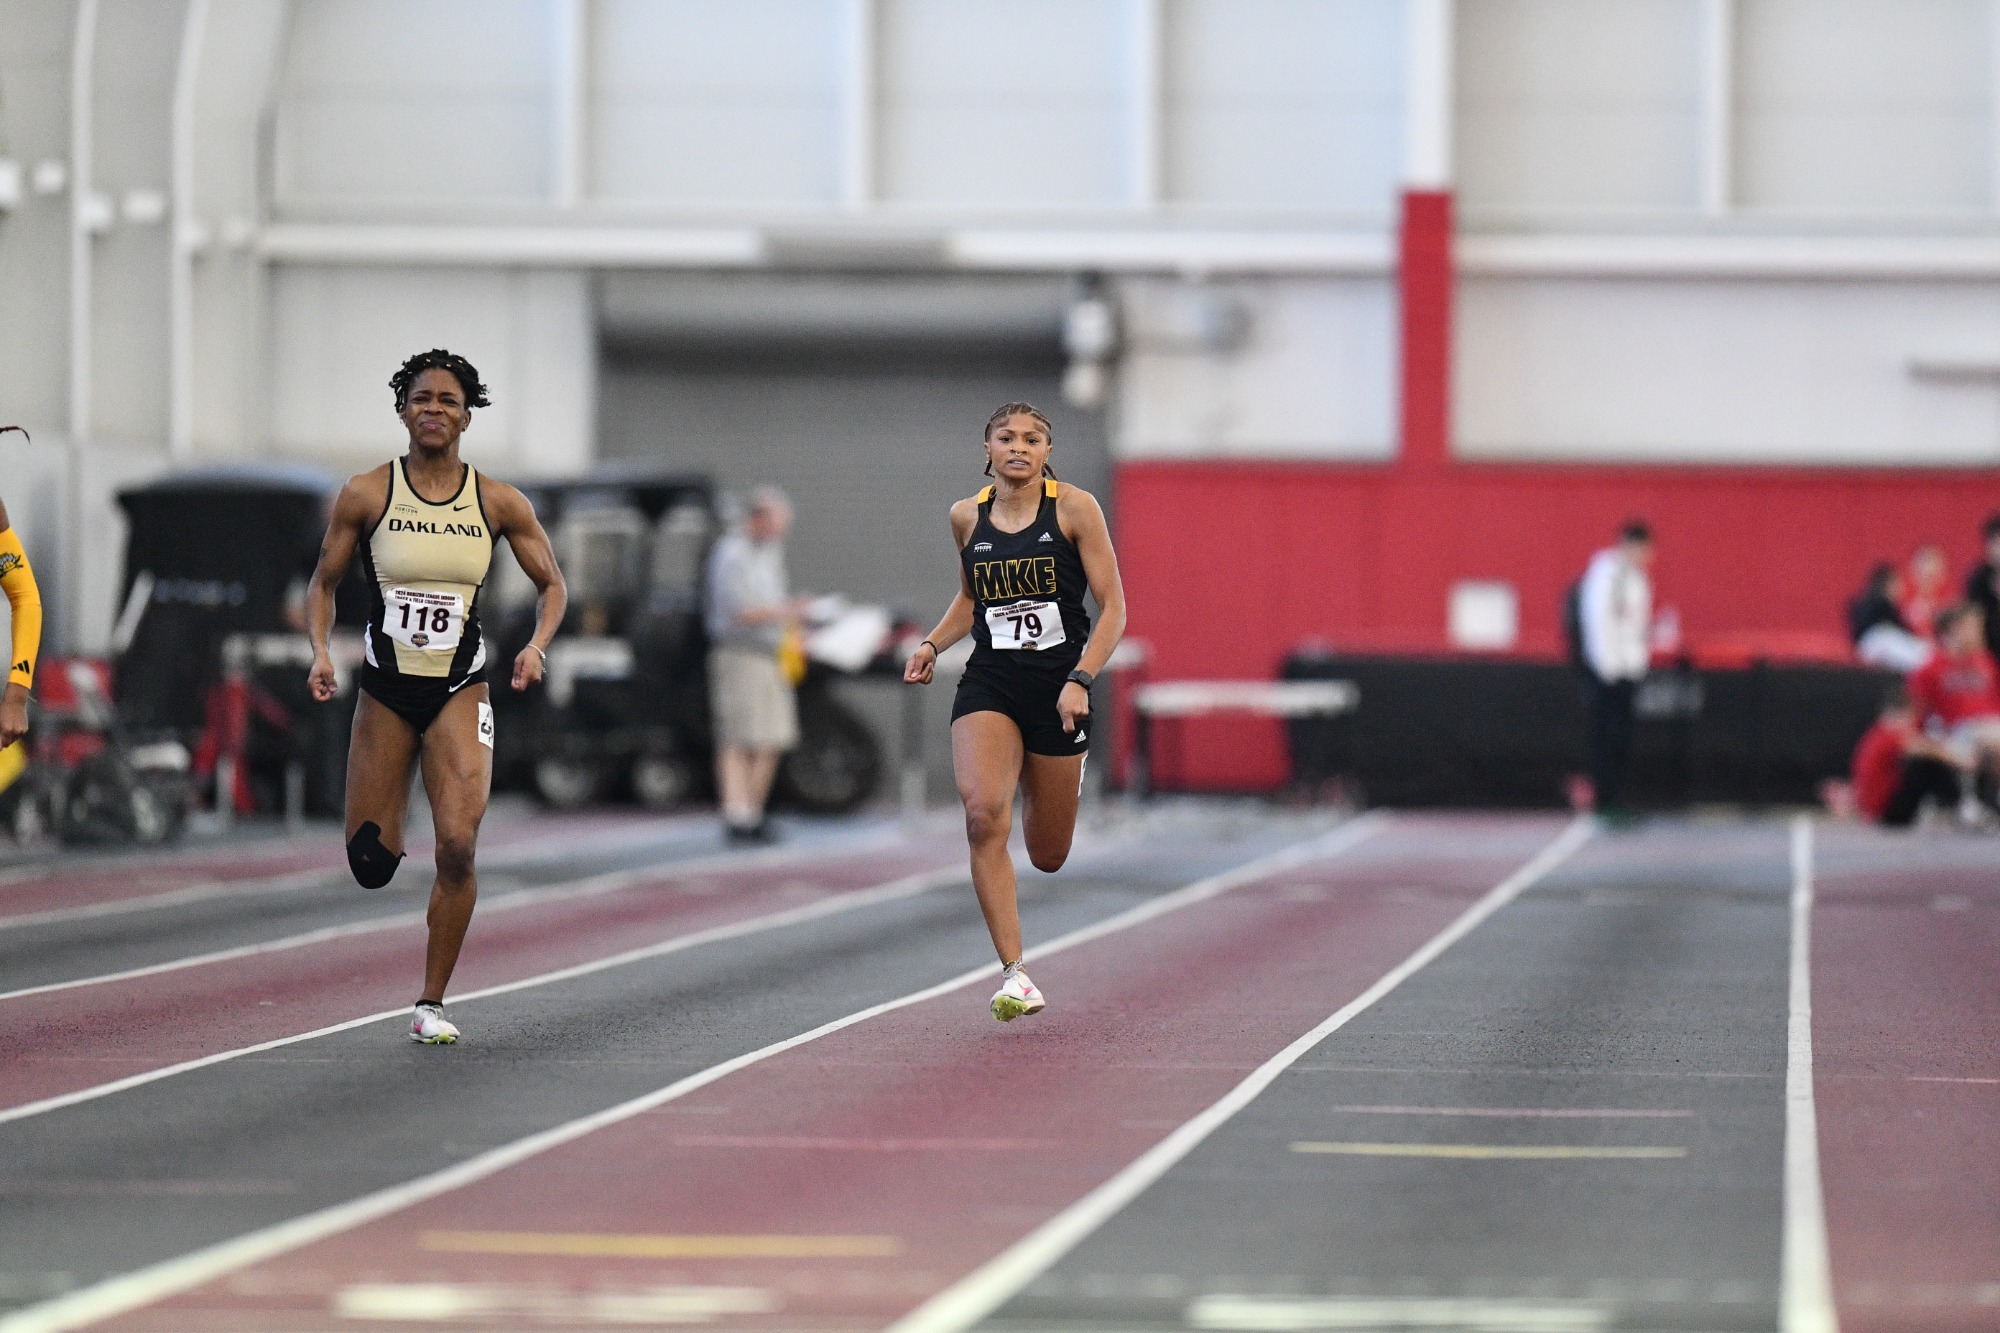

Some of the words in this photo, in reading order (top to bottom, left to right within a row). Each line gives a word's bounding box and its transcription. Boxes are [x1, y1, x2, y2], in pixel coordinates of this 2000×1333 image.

[389, 519, 482, 537] OAKLAND
[974, 557, 1057, 600] MKE
[398, 603, 450, 633] 118
[1006, 612, 1043, 641] 79
